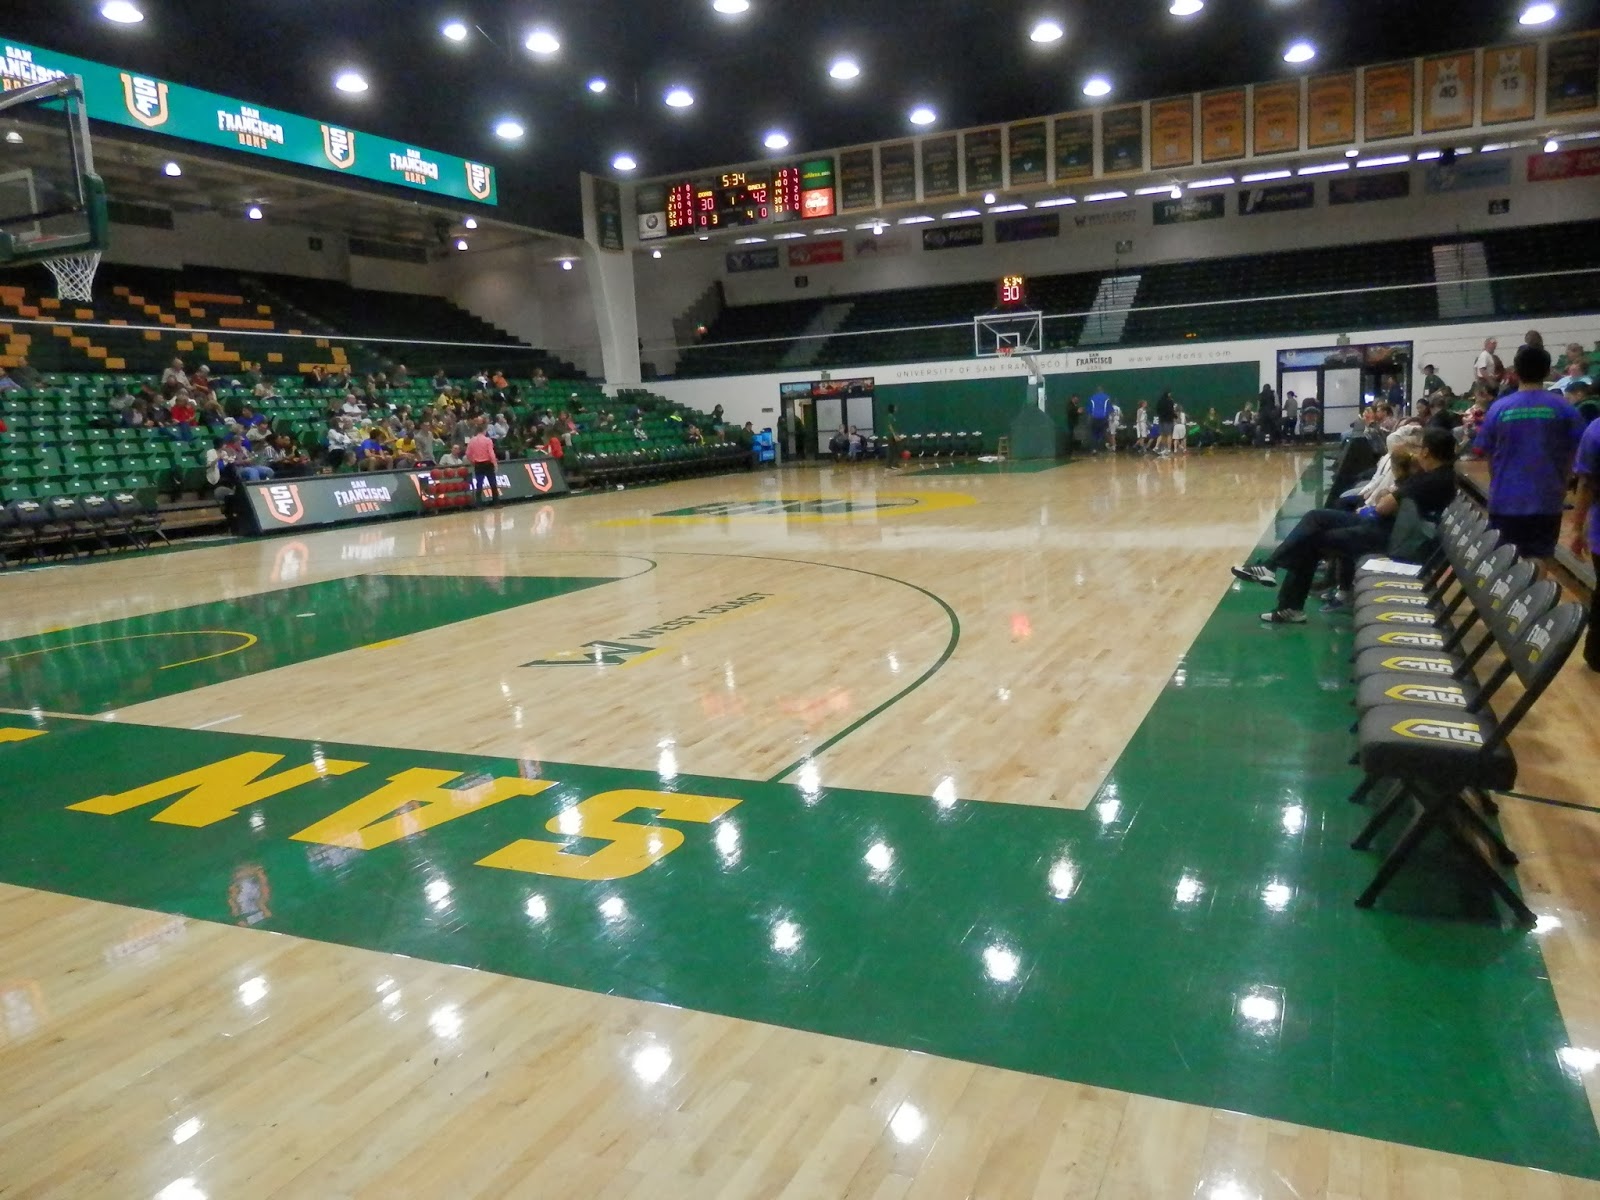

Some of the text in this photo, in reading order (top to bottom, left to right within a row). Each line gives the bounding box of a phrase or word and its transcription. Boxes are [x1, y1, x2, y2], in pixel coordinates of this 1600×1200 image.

[217, 110, 284, 144] FRANCISCO
[390, 153, 438, 180] FRANCISCO
[722, 172, 745, 187] 5:34
[752, 190, 766, 202] 42
[701, 198, 714, 211] 30
[761, 207, 767, 217] 0
[701, 215, 718, 225] 0 3
[1003, 276, 1022, 286] 5:34
[1003, 286, 1020, 300] 30
[1076, 356, 1112, 366] FRANCISCO
[897, 368, 954, 377] UNIVERSITY
[976, 365, 996, 373] SAN
[1001, 361, 1060, 372] FRANSCO
[351, 480, 366, 488] SAN
[334, 487, 391, 507] FRANCISCO
[355, 502, 380, 513] DONS
[617, 616, 706, 640] WEST
[697, 592, 775, 614] COAST
